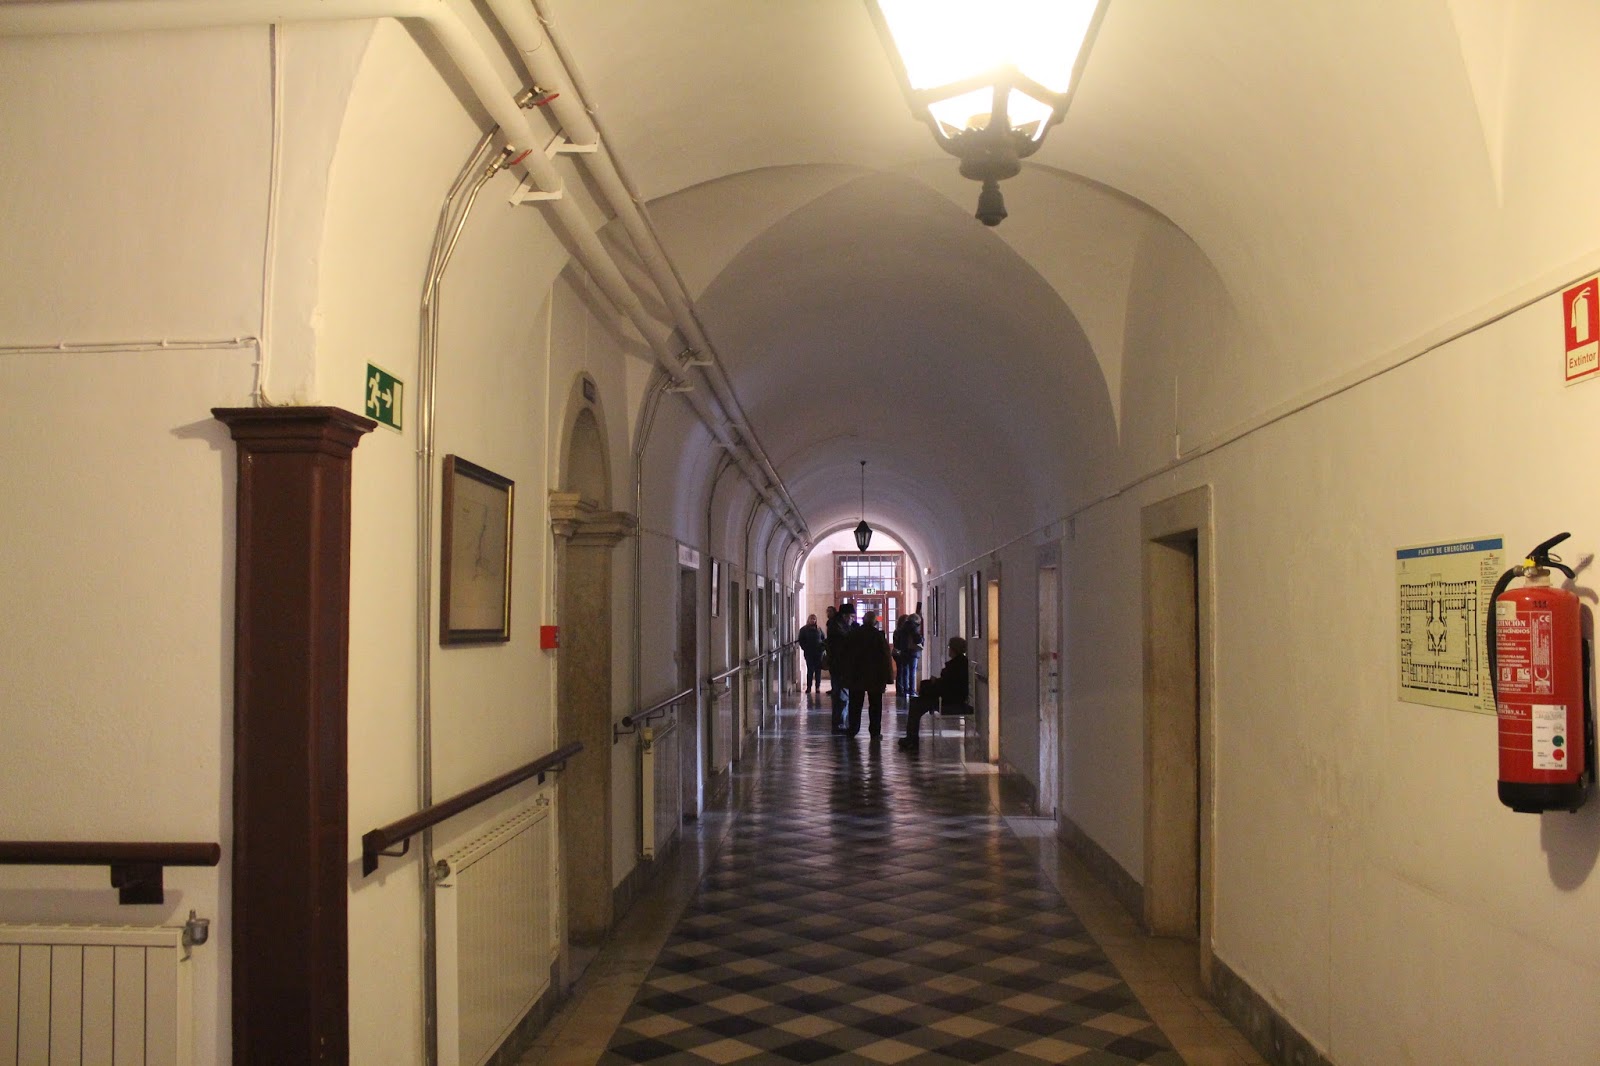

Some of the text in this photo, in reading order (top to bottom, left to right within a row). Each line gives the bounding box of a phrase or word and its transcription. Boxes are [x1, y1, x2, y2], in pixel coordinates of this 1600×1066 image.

[1569, 352, 1596, 369] Extintor
[1418, 548, 1434, 556] PLANTA
[1539, 615, 1550, 623] CE
